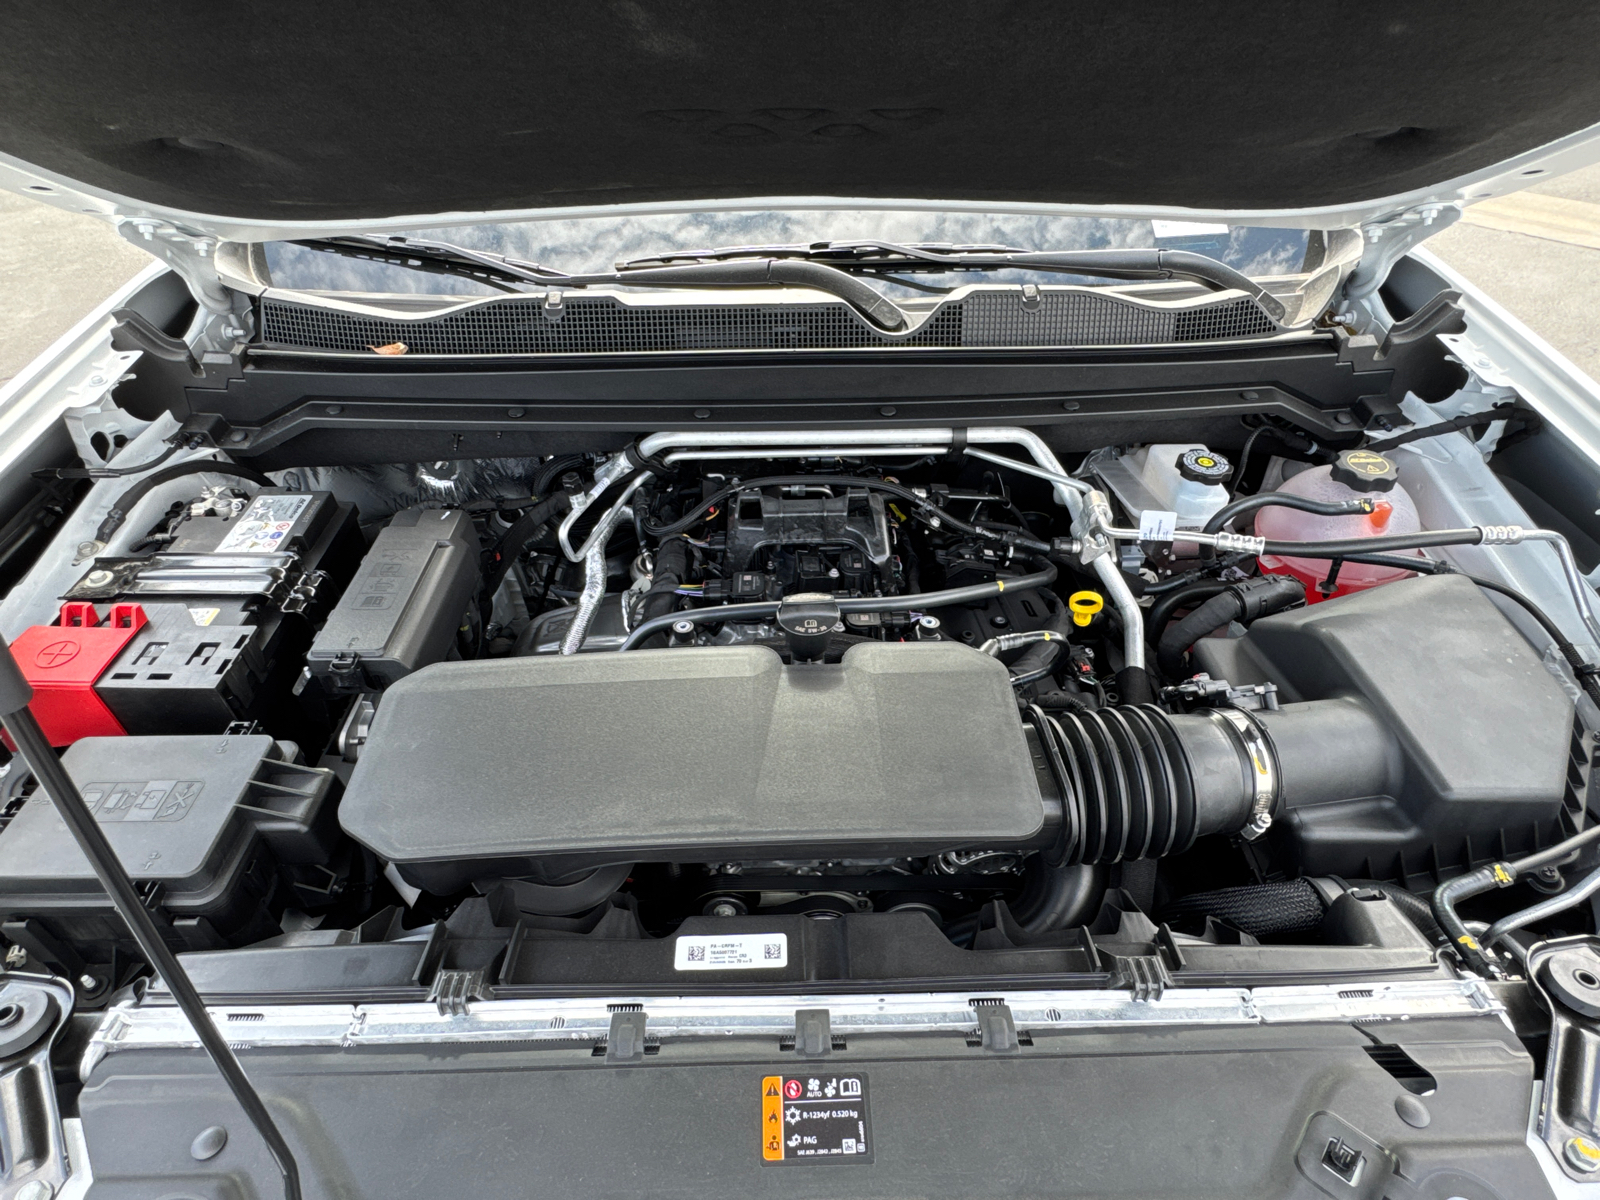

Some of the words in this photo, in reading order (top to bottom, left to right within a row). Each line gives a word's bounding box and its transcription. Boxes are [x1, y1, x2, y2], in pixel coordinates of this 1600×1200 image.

[802, 1111, 831, 1120] R-1234yf
[832, 1110, 849, 1118] 0.520
[850, 1110, 858, 1119] kg
[803, 1136, 818, 1144] PAG
